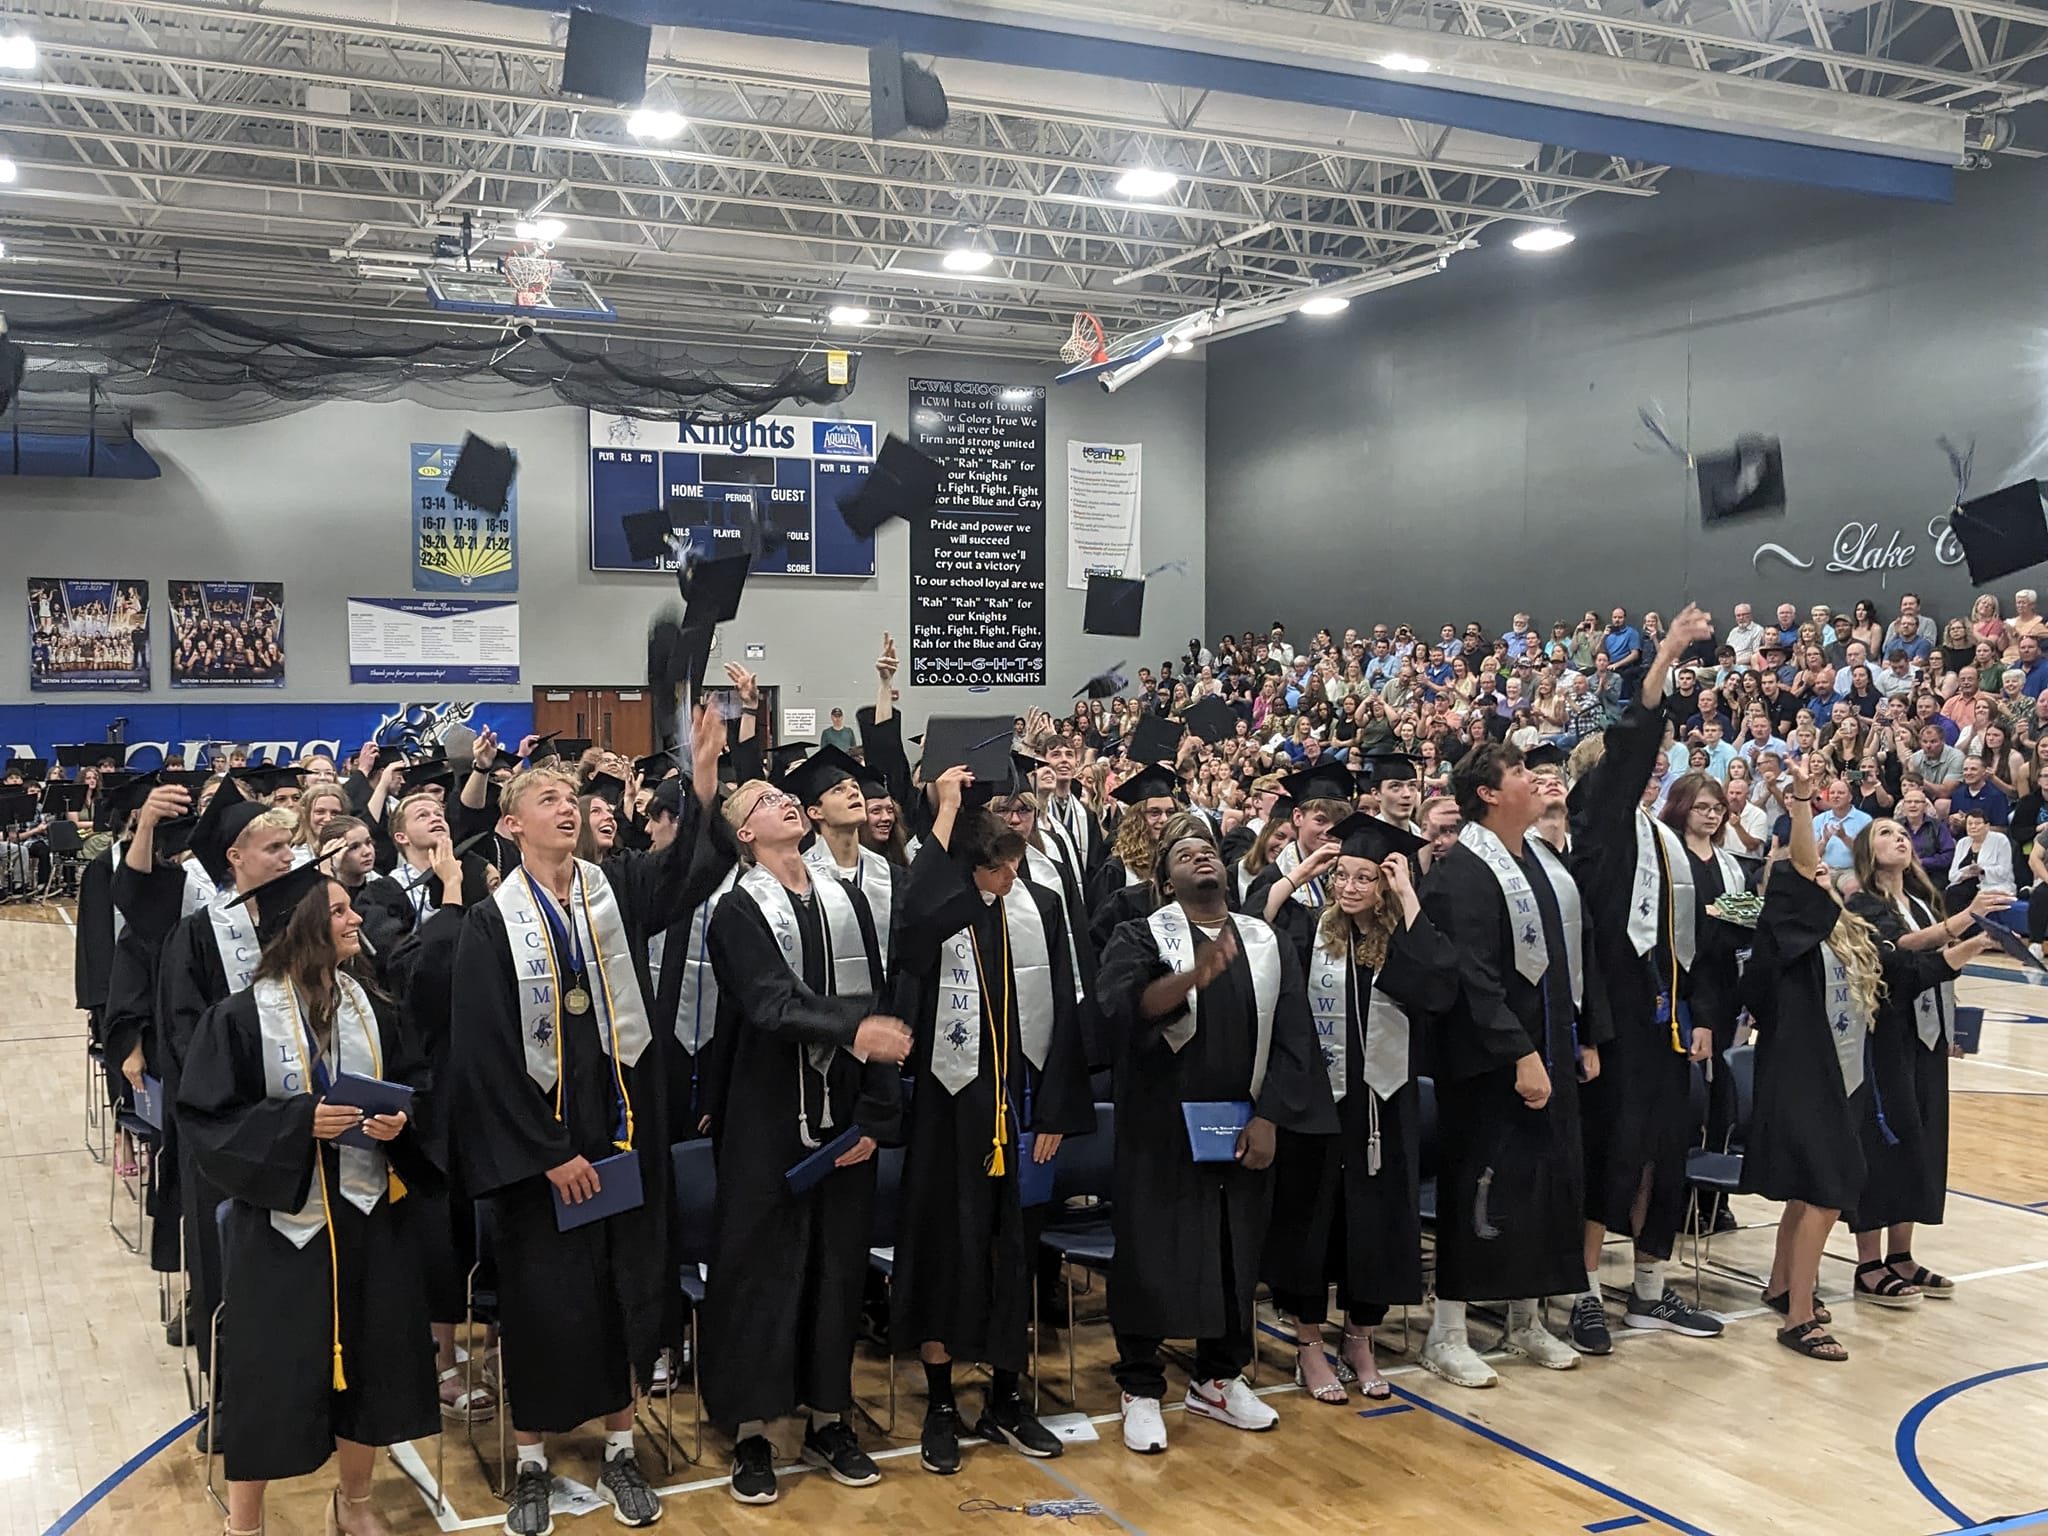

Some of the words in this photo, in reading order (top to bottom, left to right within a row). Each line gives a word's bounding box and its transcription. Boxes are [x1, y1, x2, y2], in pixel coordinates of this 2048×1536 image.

[910, 379, 952, 393] LCWM
[921, 396, 950, 407] LCWM
[954, 398, 976, 409] hats
[979, 400, 994, 410] off
[997, 401, 1008, 411] to
[1010, 402, 1033, 412] thee
[958, 413, 991, 424] Colors
[995, 415, 1017, 426] True
[1021, 416, 1038, 427] We
[678, 411, 796, 454] Knights
[948, 424, 965, 433] will
[967, 426, 990, 435] ever
[992, 425, 1005, 436] be
[823, 430, 862, 449] AQUAFINA
[920, 433, 943, 444] Firm
[945, 436, 965, 446] and
[967, 437, 1001, 449] strong
[1003, 439, 1035, 449] united
[599, 452, 614, 461] PLYR
[621, 452, 632, 462] FLS
[640, 453, 652, 463] PTS
[959, 446, 976, 455] are
[979, 447, 993, 456] we
[422, 467, 437, 475] ON
[820, 464, 835, 473] PLYR
[840, 464, 851, 473] FLS
[858, 465, 869, 474] PTS
[1020, 461, 1036, 471] for
[948, 471, 966, 480] our
[969, 470, 1008, 483] Knights
[671, 484, 704, 497] HOME
[771, 489, 806, 502] GUEST
[1013, 485, 1039, 497] Fight
[421, 497, 446, 511] 13-14
[725, 493, 752, 503] PERIOD
[952, 495, 970, 506] the
[972, 495, 994, 506] Blue
[996, 497, 1015, 507] and
[1018, 498, 1042, 510] Gray
[422, 517, 446, 530] 16-17
[454, 518, 477, 531] 17-18
[486, 519, 509, 533] 18-19
[930, 519, 958, 530] Pride
[960, 521, 980, 531] and
[981, 523, 1014, 534] power
[1016, 525, 1031, 533] we
[713, 529, 741, 539] PLAYER
[787, 532, 810, 541] FOULS
[950, 534, 967, 544] will
[969, 535, 1010, 545] succeed
[421, 535, 447, 549] 19-20
[453, 536, 478, 550] 20-21
[486, 537, 510, 551] 21-22
[1825, 521, 1916, 572] Lake
[421, 552, 447, 566] 22-23
[934, 548, 952, 558] For
[954, 550, 972, 559] our
[974, 550, 1000, 560] team
[1002, 549, 1026, 560] we'll
[666, 560, 680, 570] SCO
[786, 564, 811, 573] SCORE
[935, 561, 953, 571] cry
[955, 561, 973, 570] out
[975, 562, 982, 570] a
[984, 561, 1021, 573] victory
[914, 575, 928, 586] To
[930, 578, 948, 586] our
[950, 576, 983, 588] school
[985, 577, 1009, 590] loyal
[1011, 580, 1028, 589] are
[1030, 581, 1045, 590] we
[1018, 599, 1032, 609] for
[947, 613, 965, 621] our
[968, 611, 1007, 624] Knights
[913, 639, 933, 649] Rah
[935, 639, 951, 649] for
[953, 639, 971, 649] the
[973, 639, 995, 649] Blue
[997, 639, 1015, 649] and
[1018, 639, 1043, 651] Gray
[914, 657, 1043, 670] K-N-I-G-H-T-S
[996, 672, 1040, 683] KNIGHTS
[520, 910, 551, 1005] LCWM
[951, 930, 969, 1010] CWM
